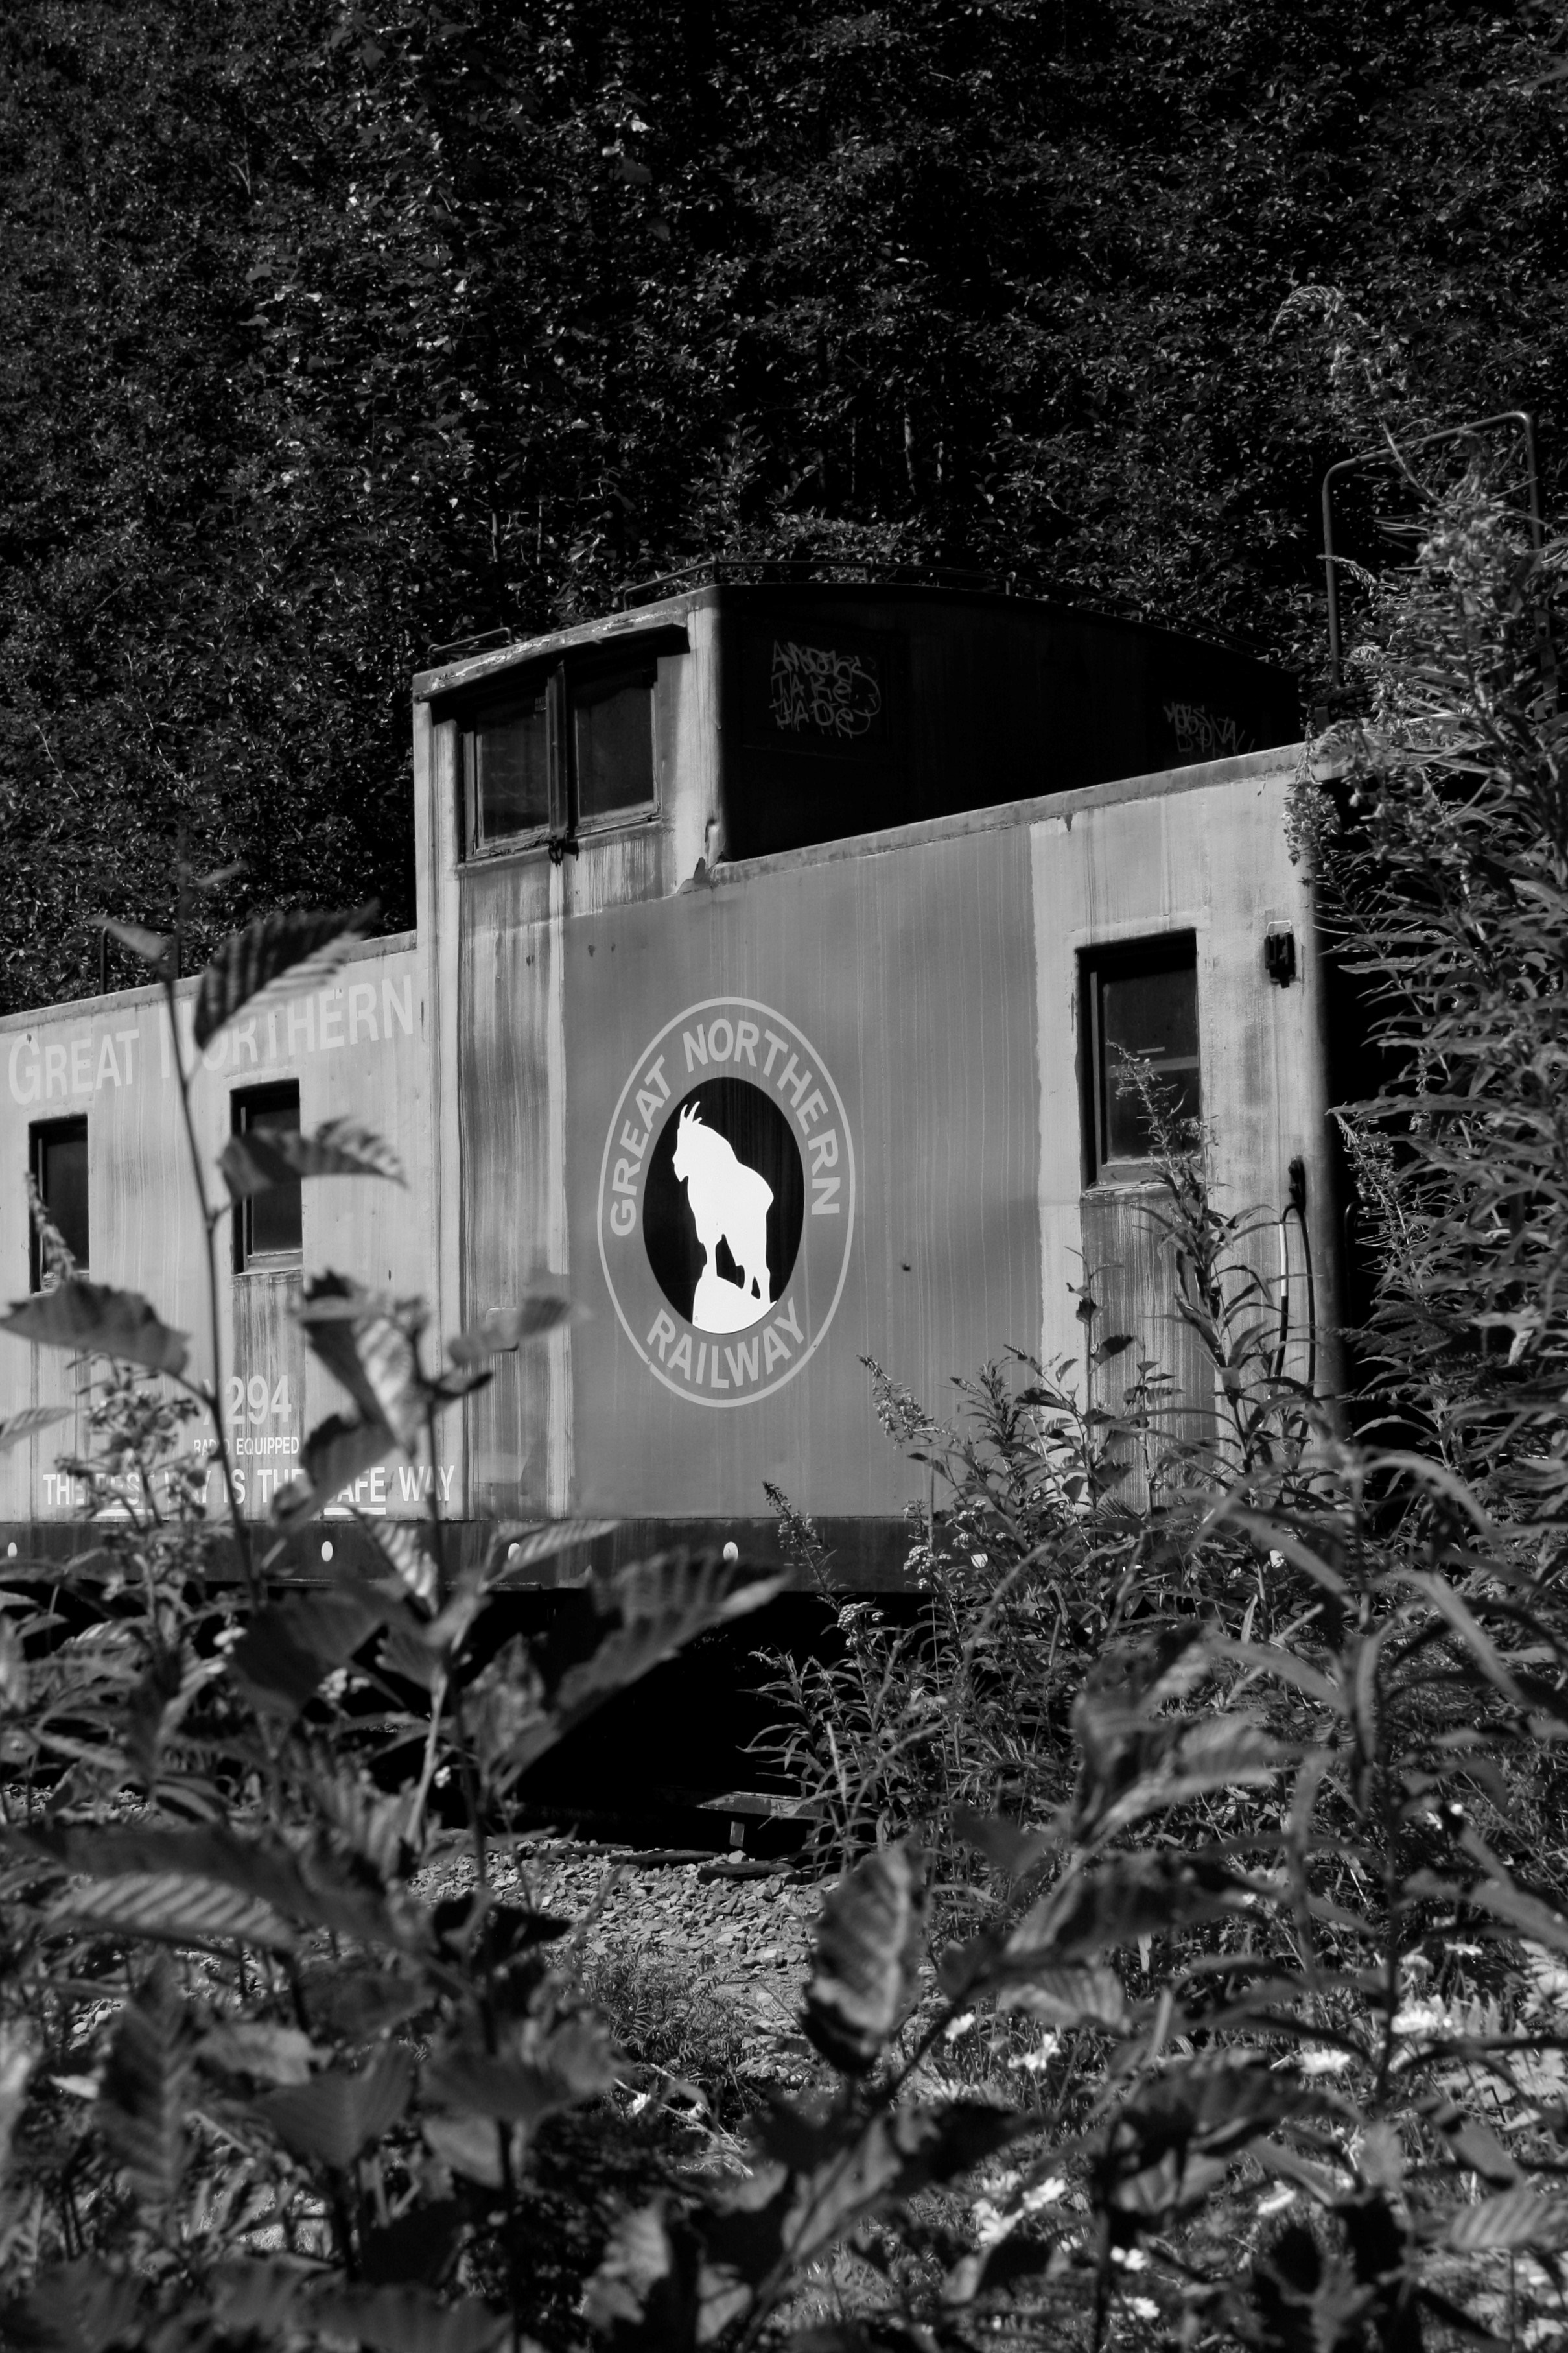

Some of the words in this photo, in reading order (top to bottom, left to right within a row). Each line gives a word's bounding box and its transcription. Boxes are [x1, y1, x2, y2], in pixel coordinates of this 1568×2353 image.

[8, 1029, 140, 1104] GREAT
[610, 1055, 672, 1236] GREAT
[683, 1019, 840, 1216] NORTHERN
[646, 1297, 804, 1388] RAILWAY
[194, 1437, 230, 1456] RADO
[236, 1436, 299, 1456] EQUIPPED
[257, 1468, 306, 1504] TH
[325, 1466, 386, 1503] AFE
